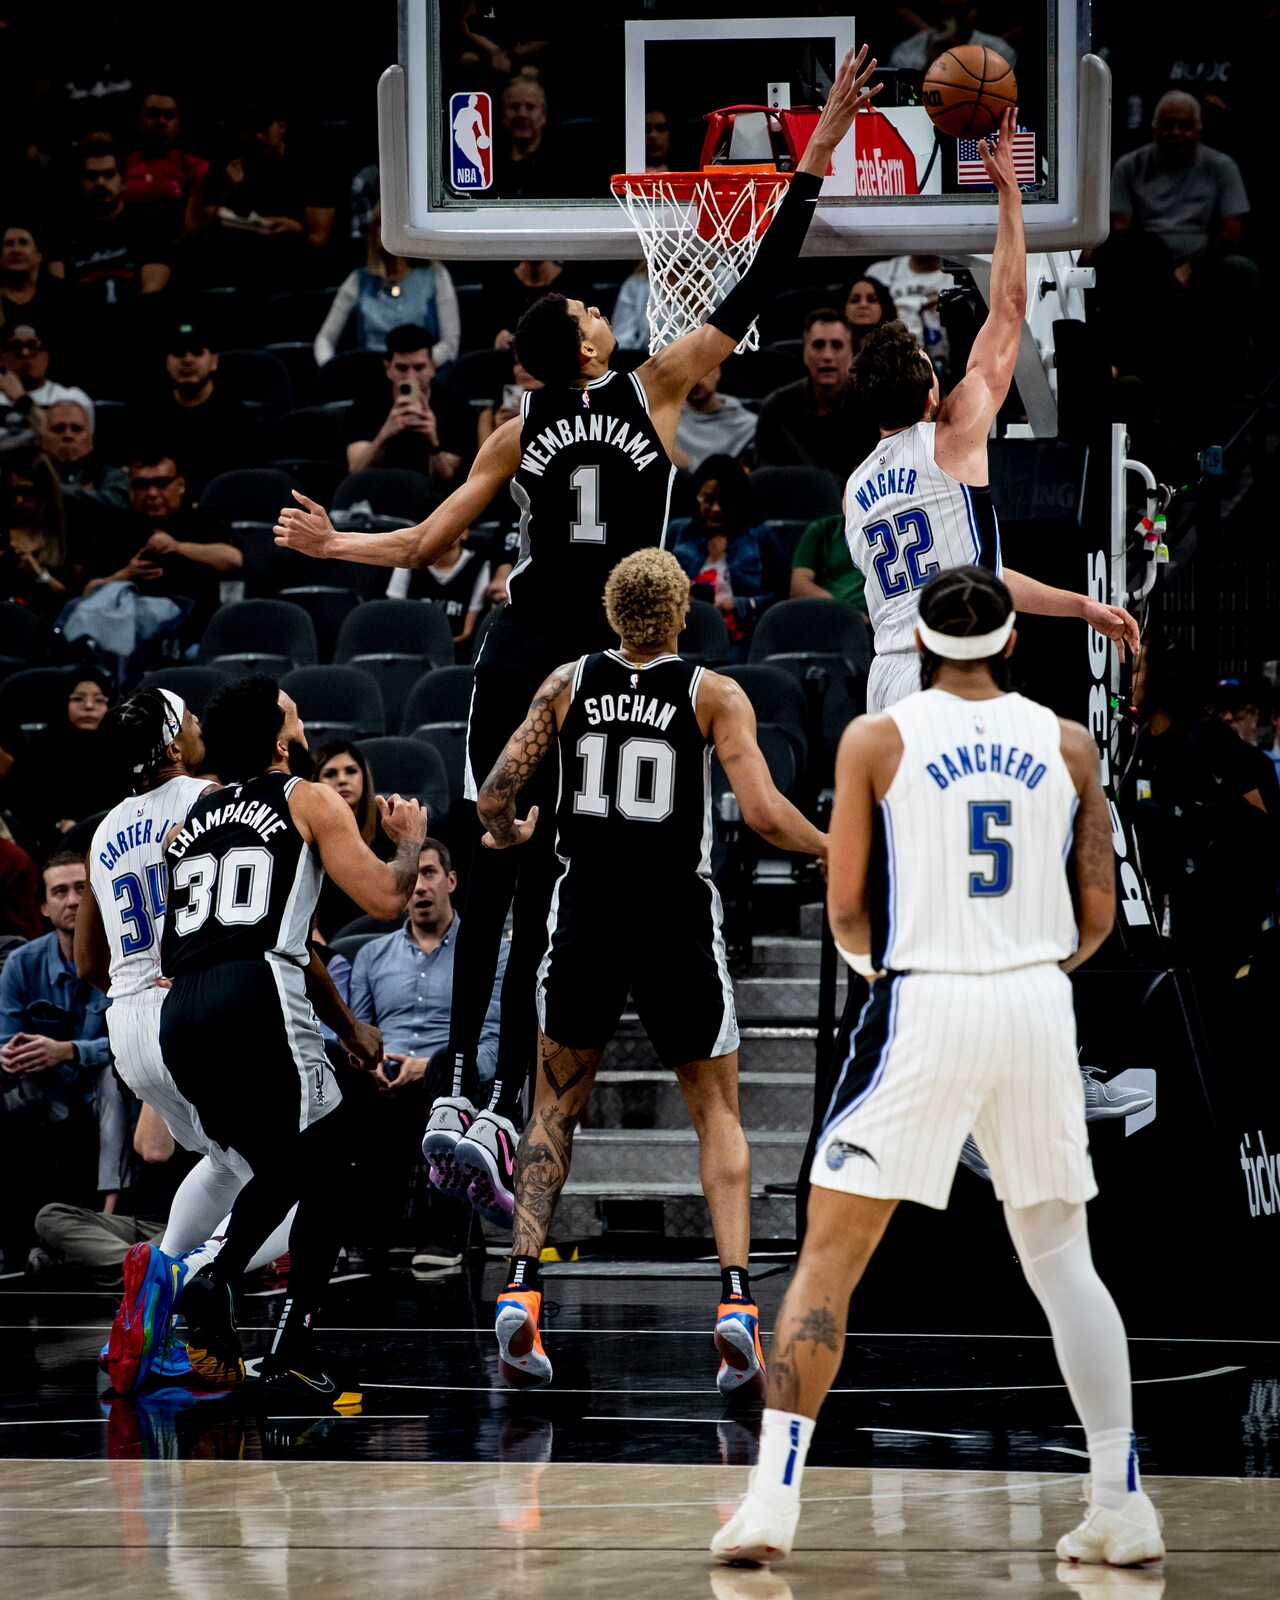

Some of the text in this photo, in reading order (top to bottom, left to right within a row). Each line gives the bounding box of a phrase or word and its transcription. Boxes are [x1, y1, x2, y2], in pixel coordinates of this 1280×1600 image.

[457, 168, 477, 183] NBA
[520, 414, 658, 477] WEMBANYAMA
[569, 464, 607, 545] 1
[855, 468, 917, 512] WAGNER
[862, 508, 941, 600] 22
[584, 694, 677, 732] SOCHAN
[572, 732, 677, 823] 10
[926, 744, 1047, 789] BANCHERO
[100, 819, 152, 871] CARTER
[168, 800, 287, 858] CHAMPAGNIE
[968, 801, 1013, 898] 5
[172, 846, 274, 937] 30
[1240, 1130, 1280, 1217] tick
